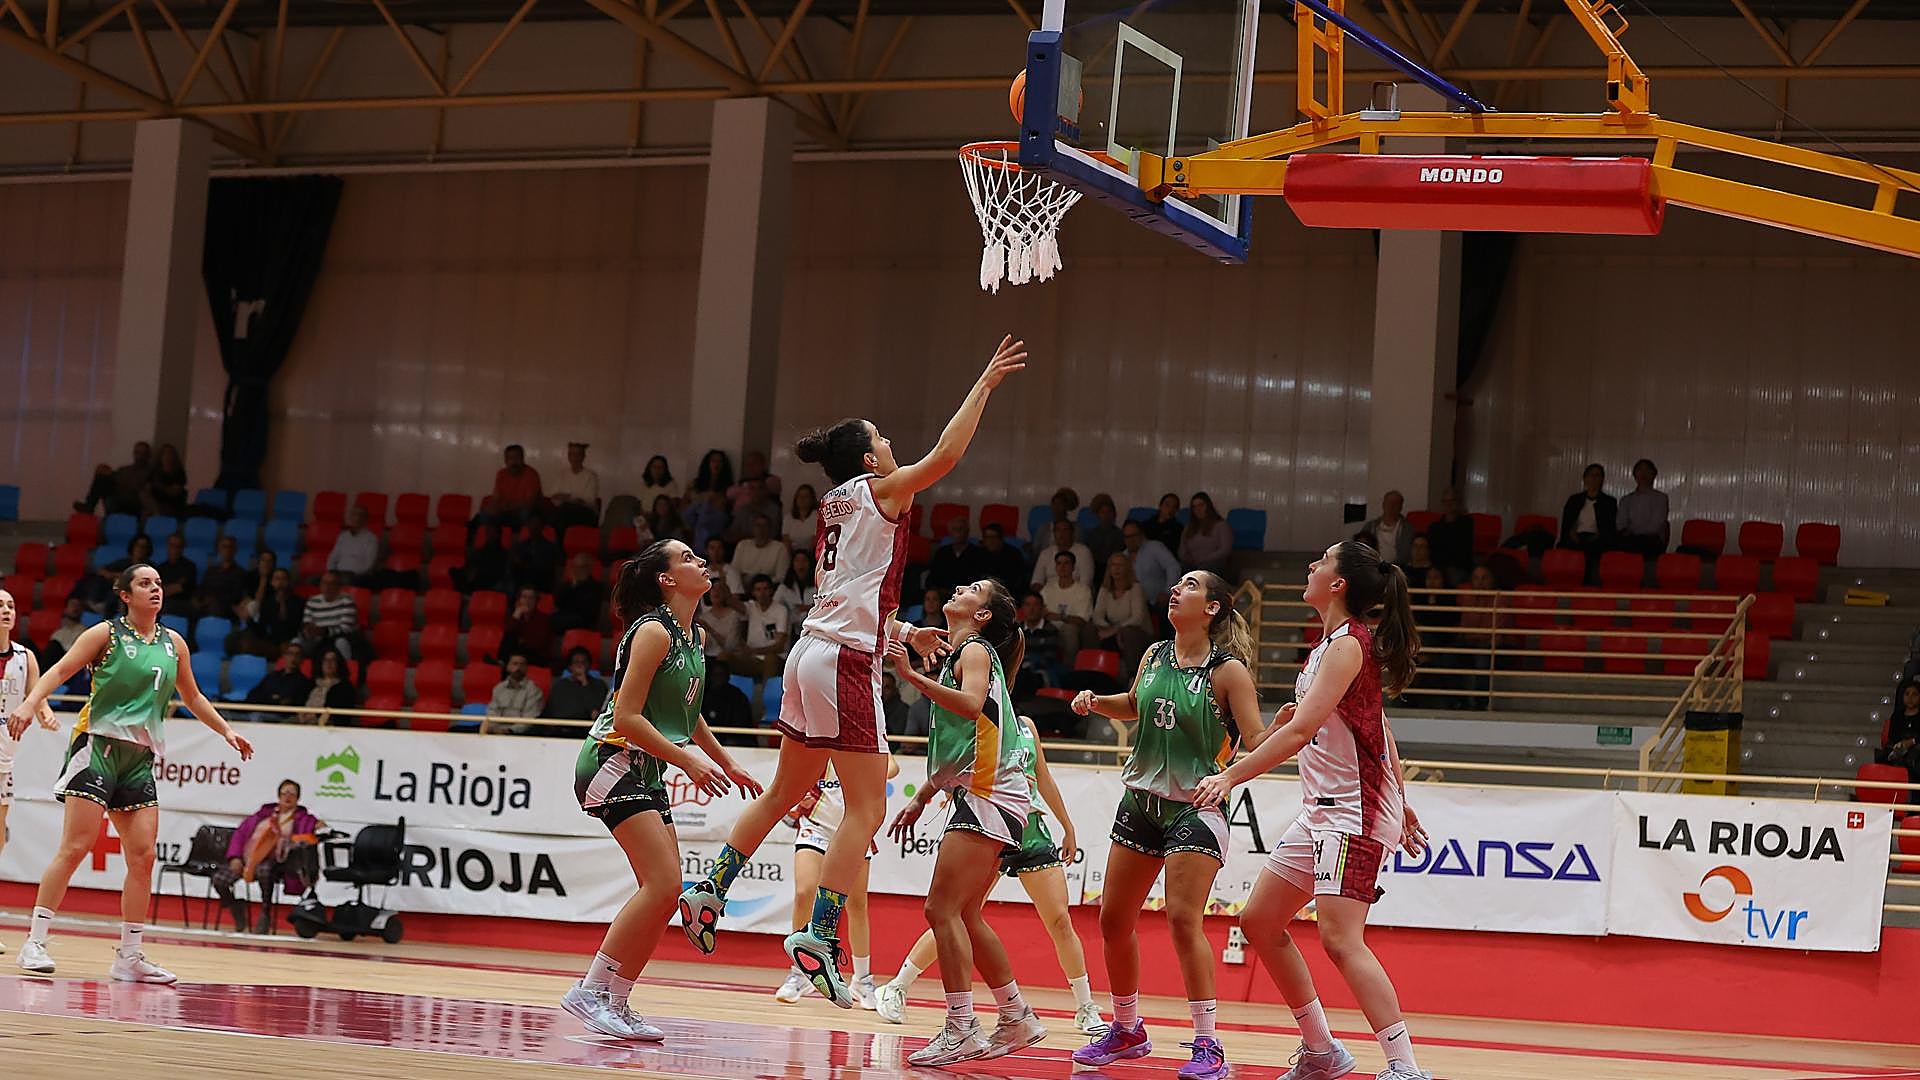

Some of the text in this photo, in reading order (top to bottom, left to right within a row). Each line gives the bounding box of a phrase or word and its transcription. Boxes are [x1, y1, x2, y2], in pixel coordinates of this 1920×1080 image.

[1420, 167, 1503, 183] MONDO
[822, 523, 842, 572] 8
[151, 666, 163, 691] 7
[1153, 697, 1176, 730] 33
[154, 757, 241, 787] deporte
[374, 759, 532, 816] La Rioja
[1638, 815, 1845, 862] LA RIOJA
[401, 843, 567, 897] RIOJA
[1382, 838, 1601, 882] DANSA
[1742, 900, 1808, 941] tvr
